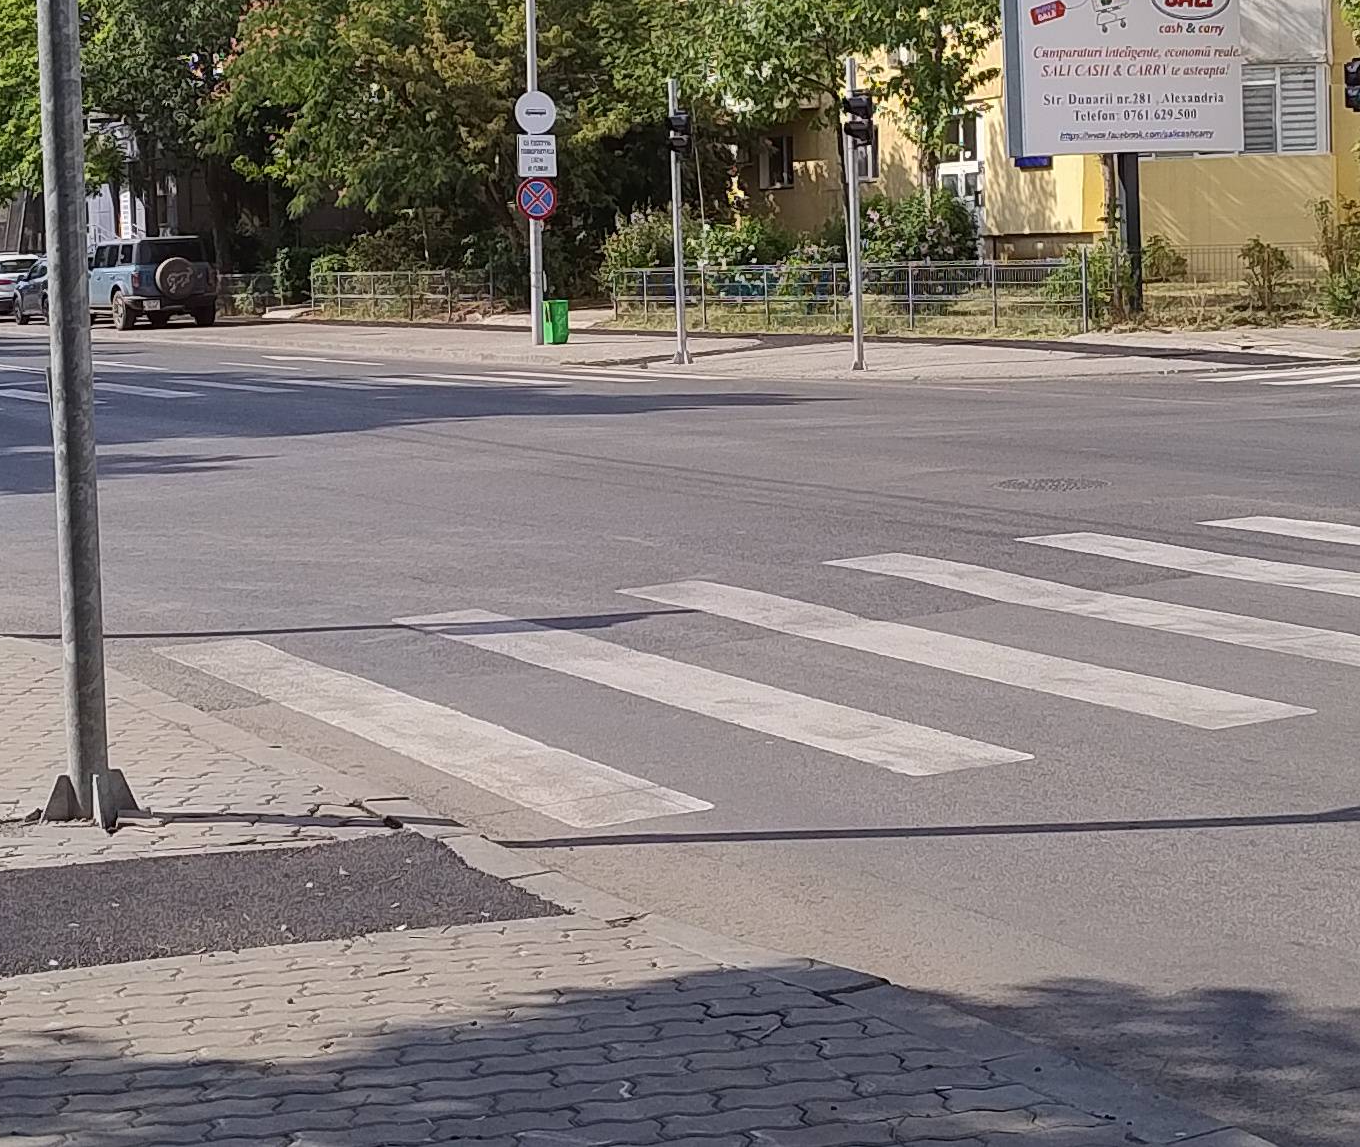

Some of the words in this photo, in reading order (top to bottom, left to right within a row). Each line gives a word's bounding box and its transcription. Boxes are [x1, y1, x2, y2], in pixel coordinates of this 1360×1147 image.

[1159, 22, 1183, 34] cash
[1186, 22, 1196, 34] &
[1198, 24, 1225, 36] carry
[1041, 64, 1071, 78] SALI
[1074, 63, 1110, 77] CASH
[1113, 64, 1122, 77] &
[1126, 63, 1169, 77] CARRY
[1171, 65, 1181, 76] te
[1068, 93, 1113, 105] Dunarii
